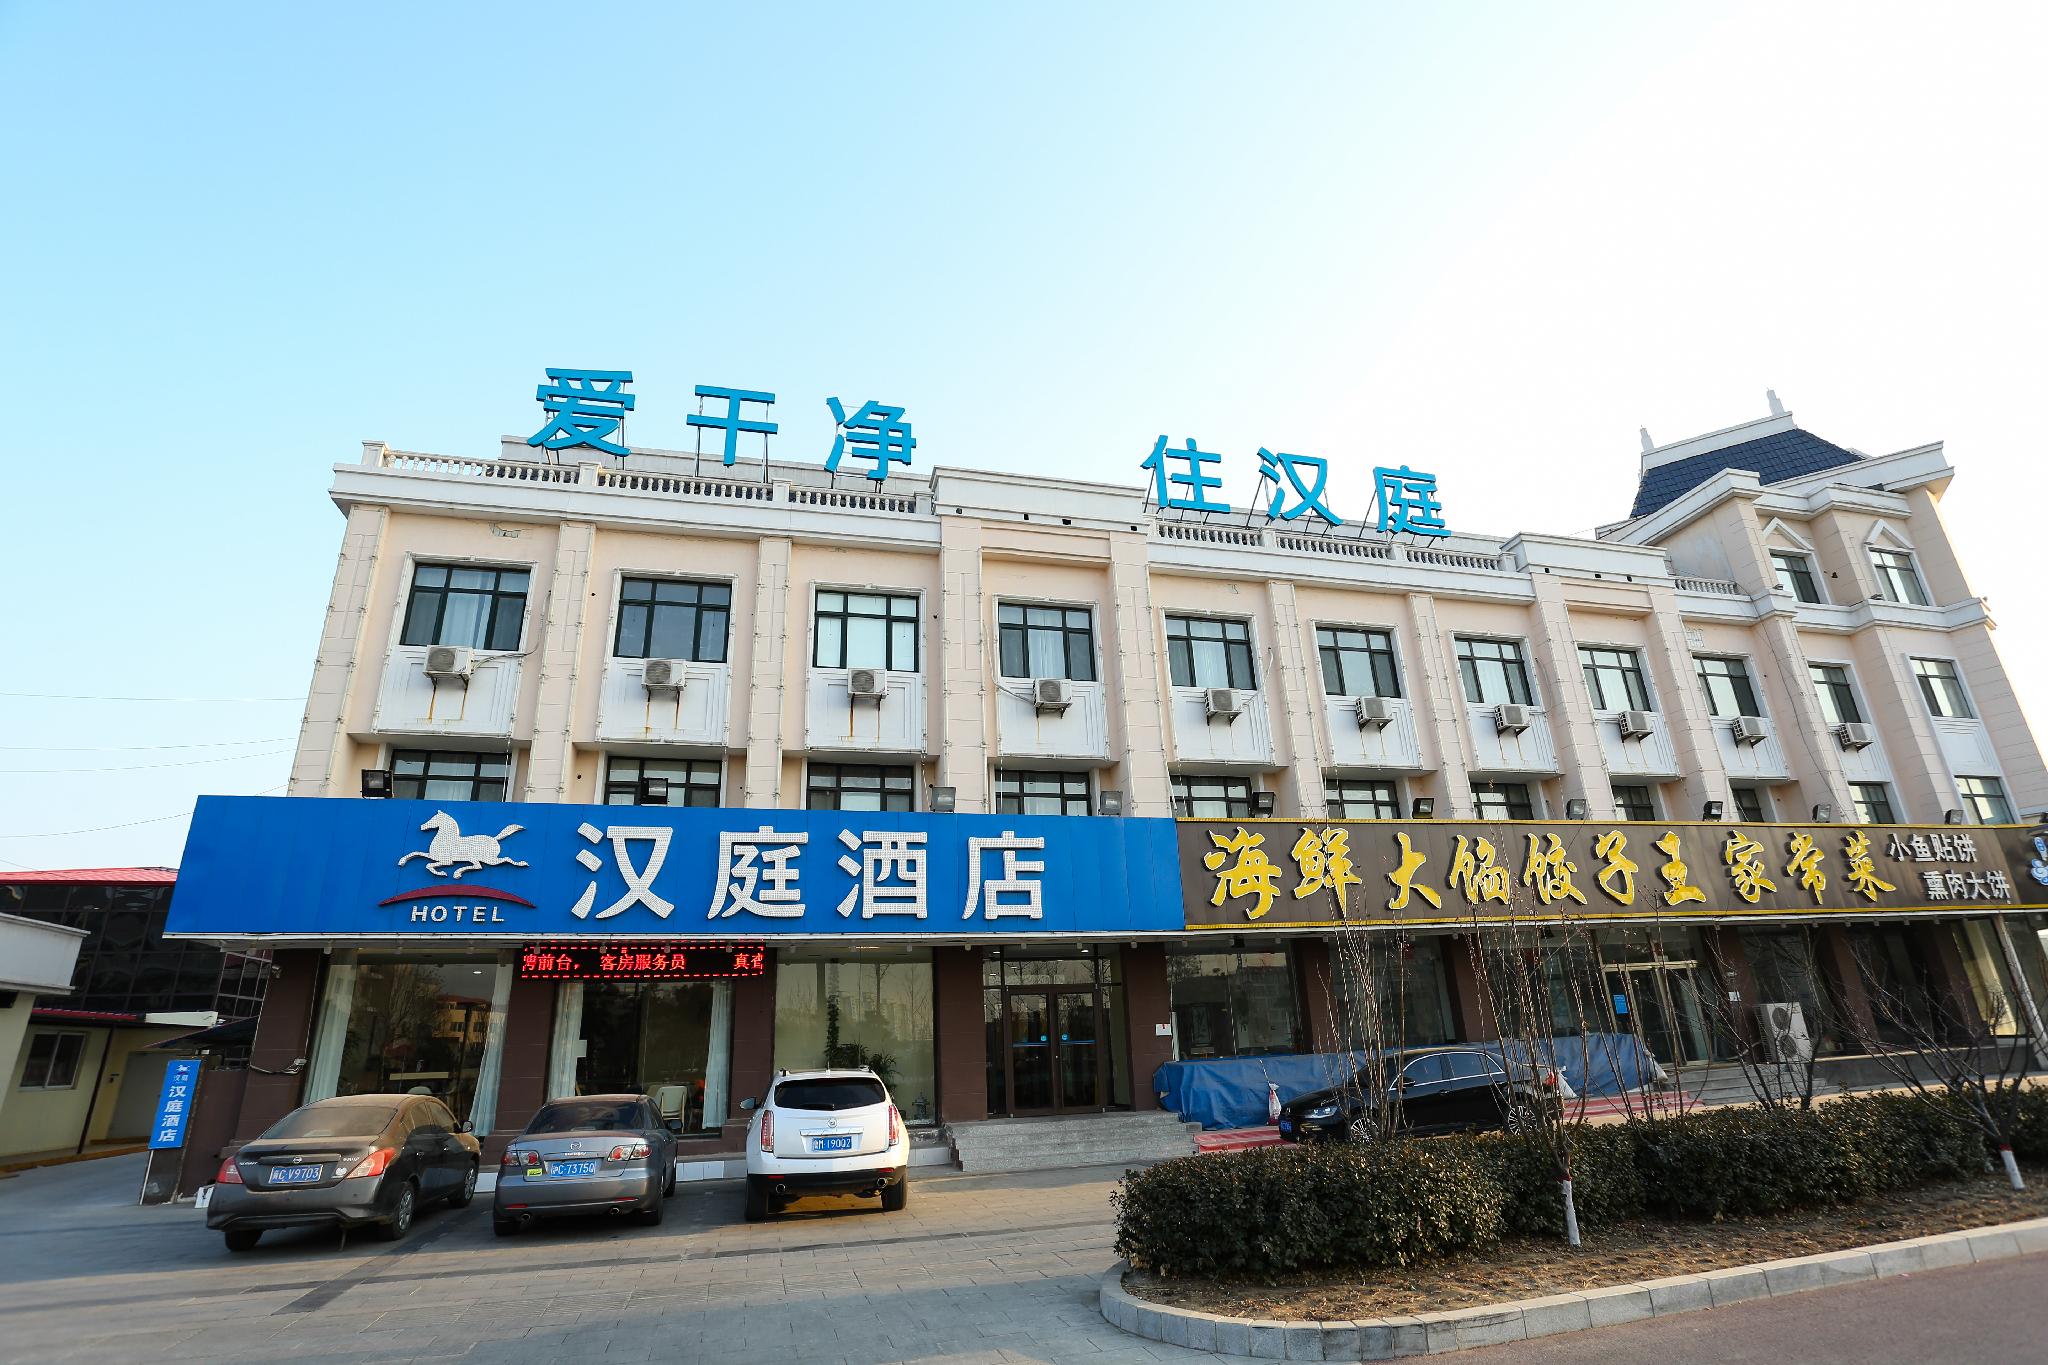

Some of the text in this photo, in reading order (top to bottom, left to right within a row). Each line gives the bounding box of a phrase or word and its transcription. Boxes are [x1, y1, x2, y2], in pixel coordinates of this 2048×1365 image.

[527, 367, 1453, 538] 爱干净 住汉庭
[1888, 832, 1978, 862] 小鱼贴饼
[571, 822, 1046, 919] 汉庭酒店
[1204, 826, 1896, 920] 海鲜大馅饺子王家常菜
[1923, 869, 2012, 905] 熏肉大饼
[410, 905, 505, 922] HOTEL
[600, 953, 687, 971] 客房服务员
[158, 1085, 187, 1142] 汉庭酒店
